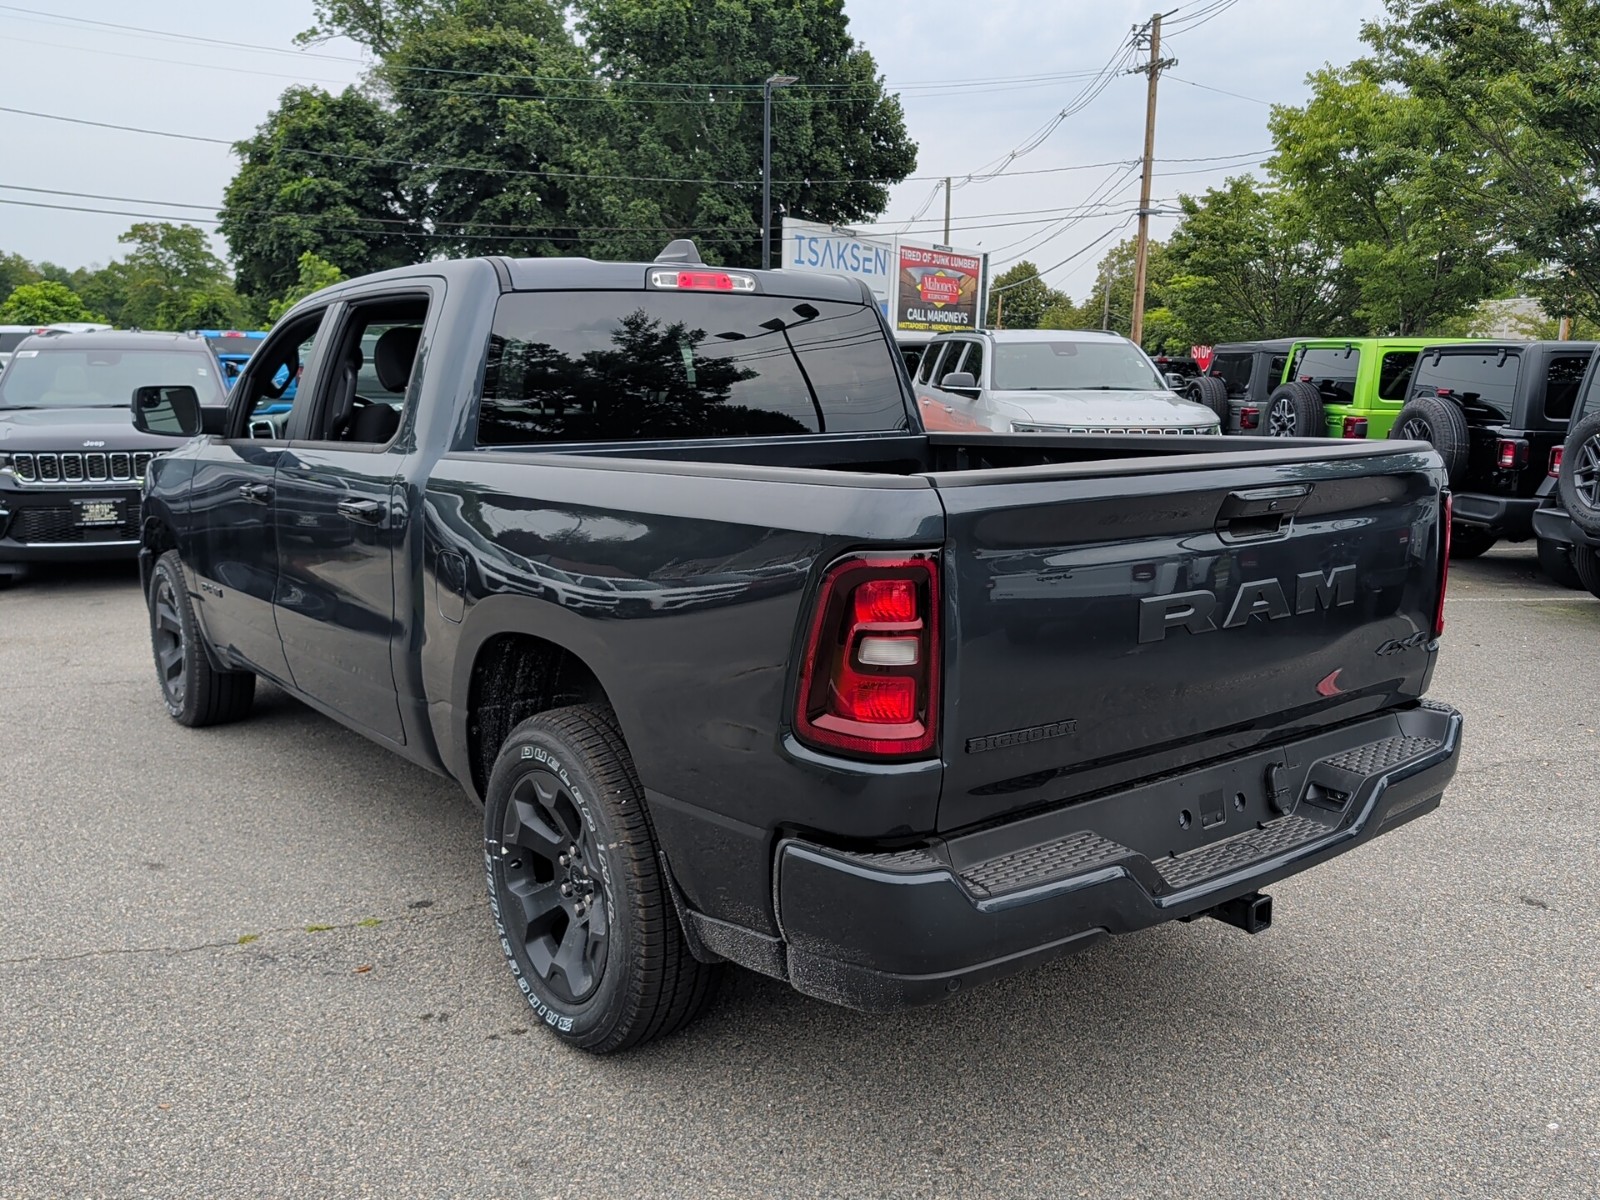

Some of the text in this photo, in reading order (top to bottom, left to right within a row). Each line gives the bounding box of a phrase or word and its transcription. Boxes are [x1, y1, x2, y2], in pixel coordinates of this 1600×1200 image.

[794, 234, 886, 276] ISAKSEN
[901, 248, 921, 262] TIRED
[922, 252, 932, 263] OF
[932, 254, 949, 266] JUNK
[950, 257, 978, 270] LUMBER?
[924, 276, 958, 293] Mahoney's
[907, 308, 968, 324] CALL MAHONEY'S
[1192, 345, 1212, 359] STOP
[83, 440, 105, 448] Jeep
[1138, 564, 1356, 644] RAM
[520, 746, 597, 833] DUELER
